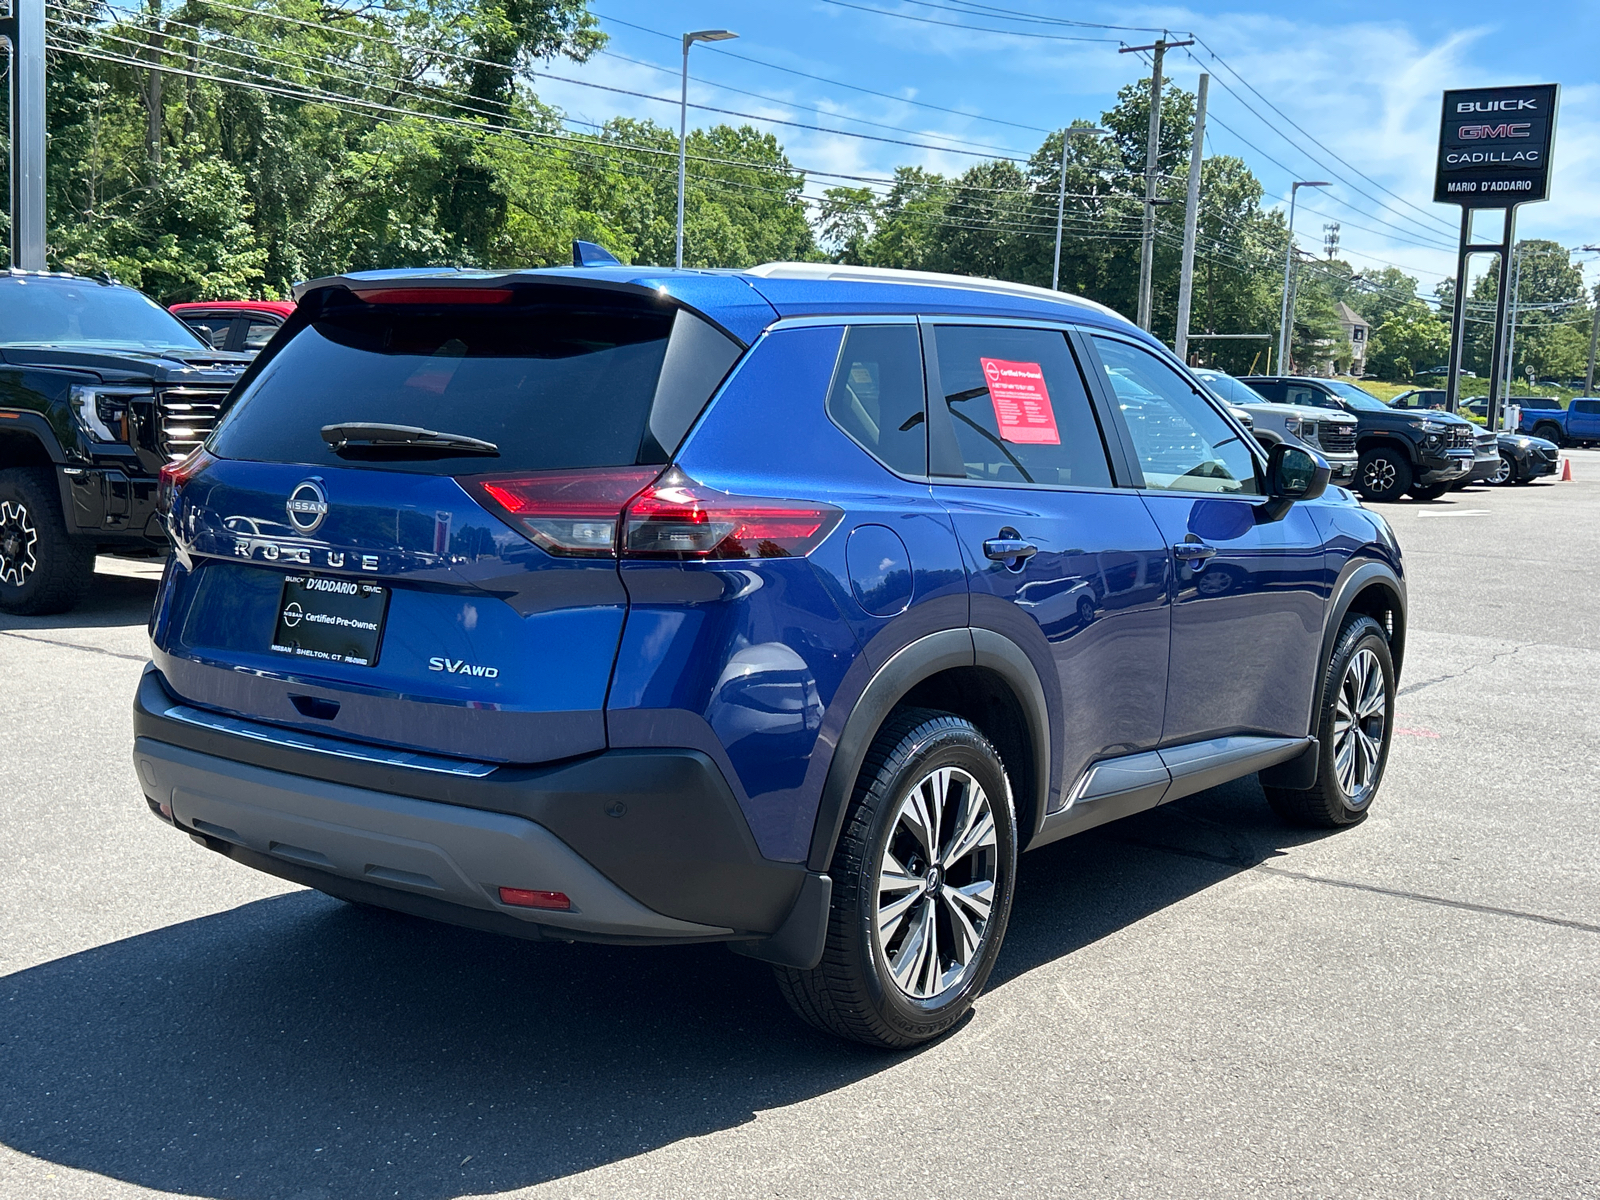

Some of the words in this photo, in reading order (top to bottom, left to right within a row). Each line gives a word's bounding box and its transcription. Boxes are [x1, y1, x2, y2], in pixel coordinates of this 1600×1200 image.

[1457, 99, 1537, 112] BUICK
[1459, 123, 1531, 139] GMC
[1447, 151, 1538, 163] CADILLAC
[1448, 181, 1477, 192] MARIO
[1481, 180, 1532, 191] D'ADDARIO
[286, 501, 327, 512] NISSAN
[234, 540, 379, 571] ROGUE
[285, 575, 305, 583] BUICK
[306, 578, 358, 595] D'ADDARIO
[362, 585, 382, 593] GMC
[305, 613, 336, 625] Certified
[271, 644, 292, 653] NISSAN
[296, 648, 330, 660] SHELTON,
[331, 653, 342, 661] CT
[428, 657, 463, 673] SV
[459, 664, 499, 678] AWD
